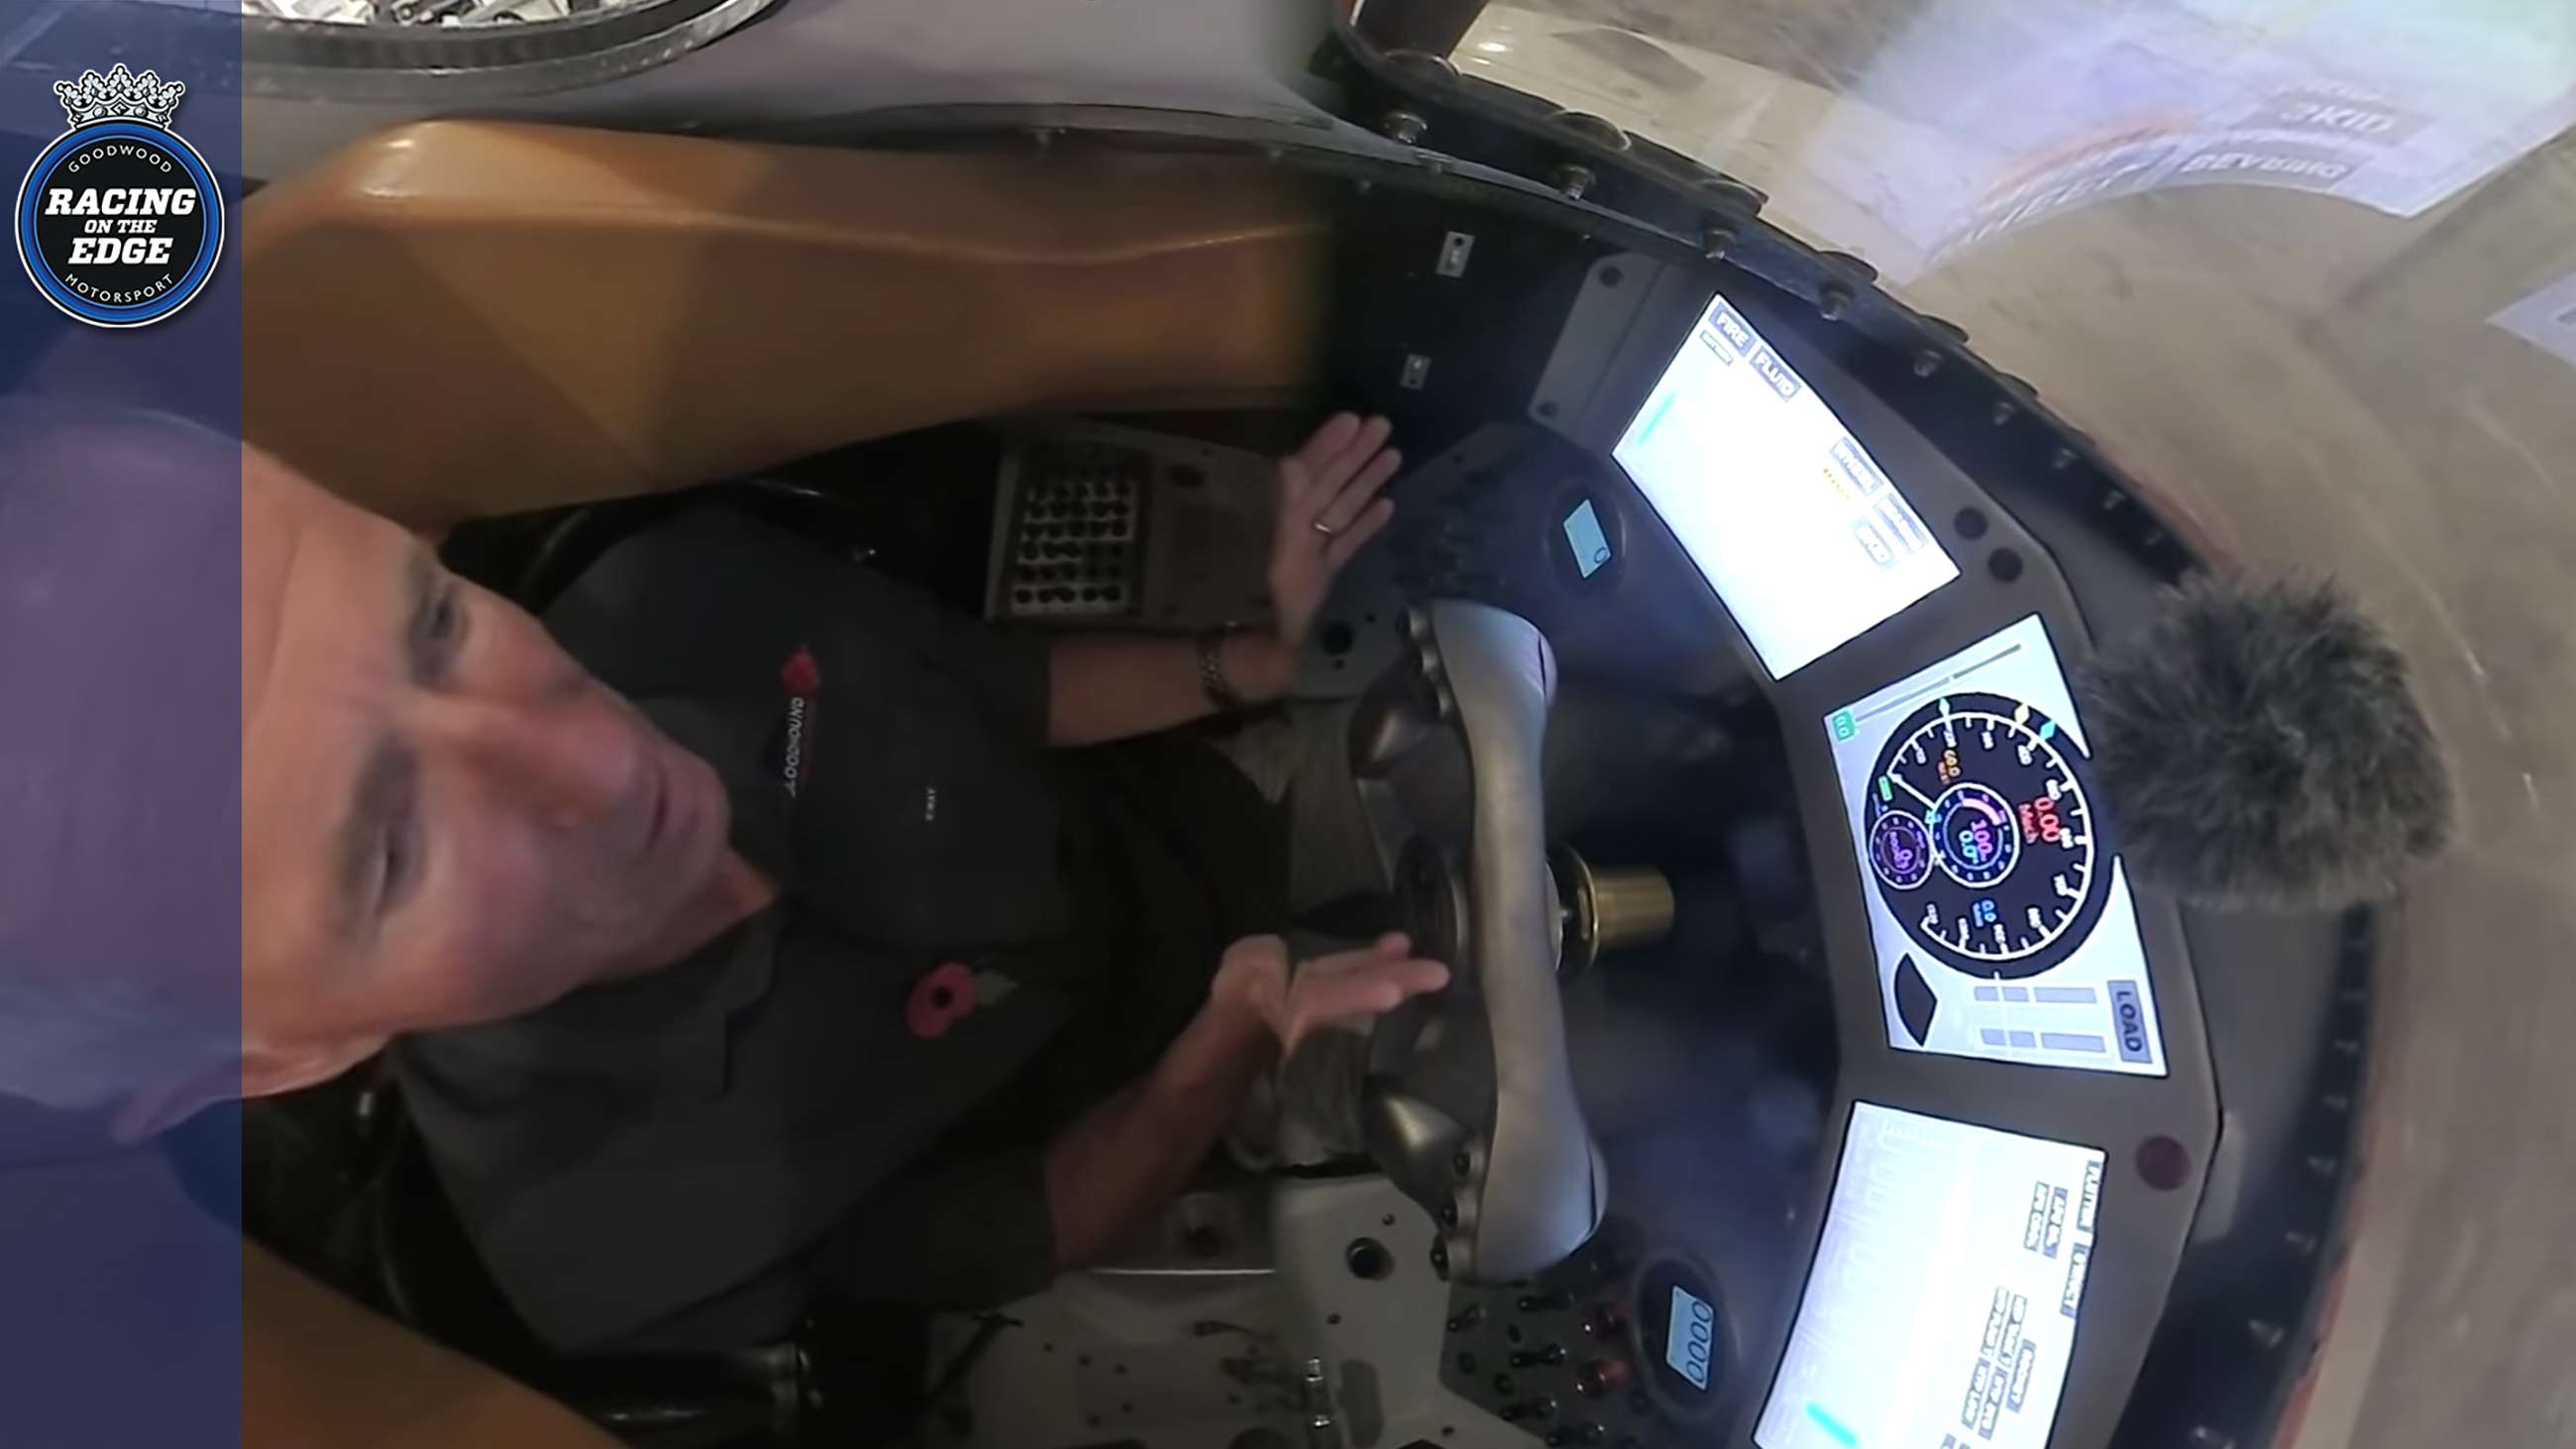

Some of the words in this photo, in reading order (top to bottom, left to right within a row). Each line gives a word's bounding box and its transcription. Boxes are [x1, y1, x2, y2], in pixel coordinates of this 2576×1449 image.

[1716, 312, 1751, 348] FIRE
[1755, 352, 1795, 397] FLUID
[2033, 796, 2061, 843] 0.00
[2116, 990, 2143, 1053] LOAD
[1686, 1300, 1712, 1384] 0000
